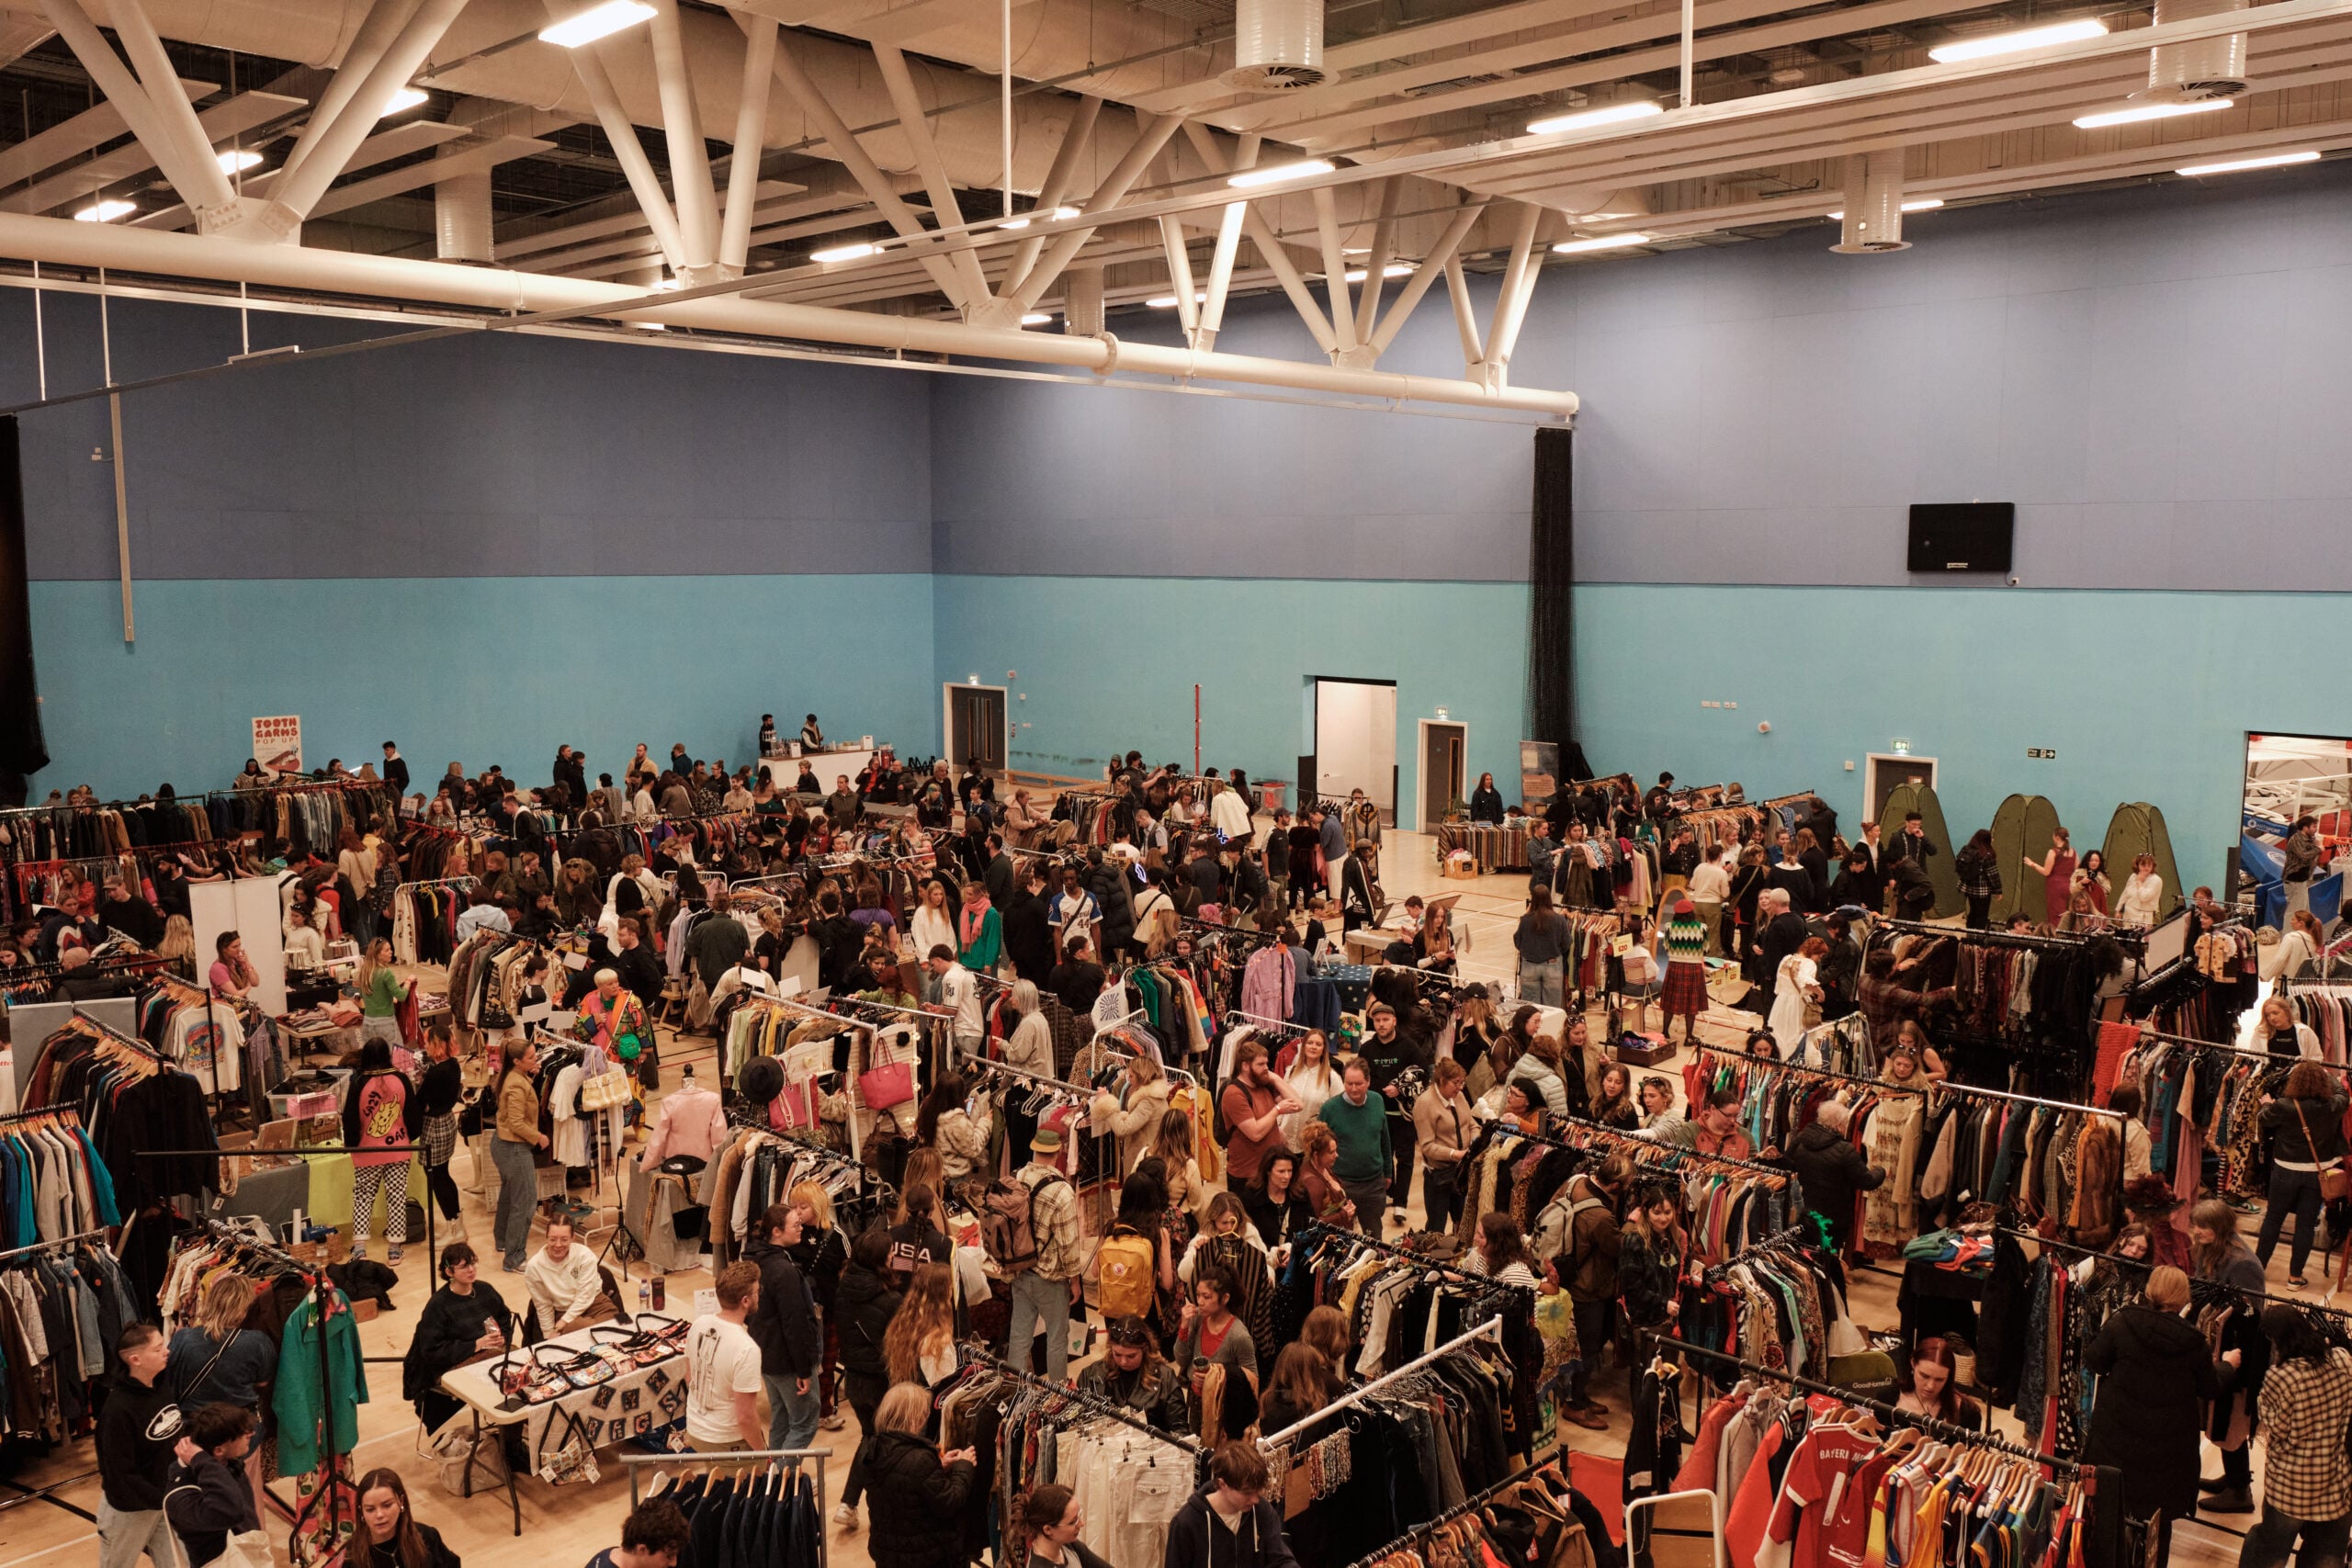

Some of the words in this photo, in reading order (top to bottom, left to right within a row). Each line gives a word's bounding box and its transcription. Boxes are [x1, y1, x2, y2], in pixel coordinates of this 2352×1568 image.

[255, 717, 297, 728] TOOTH
[255, 728, 298, 738] GARMS
[1078, 919, 1090, 929] 44
[385, 1128, 405, 1145] OAF
[1823, 1471, 1846, 1526] 1
